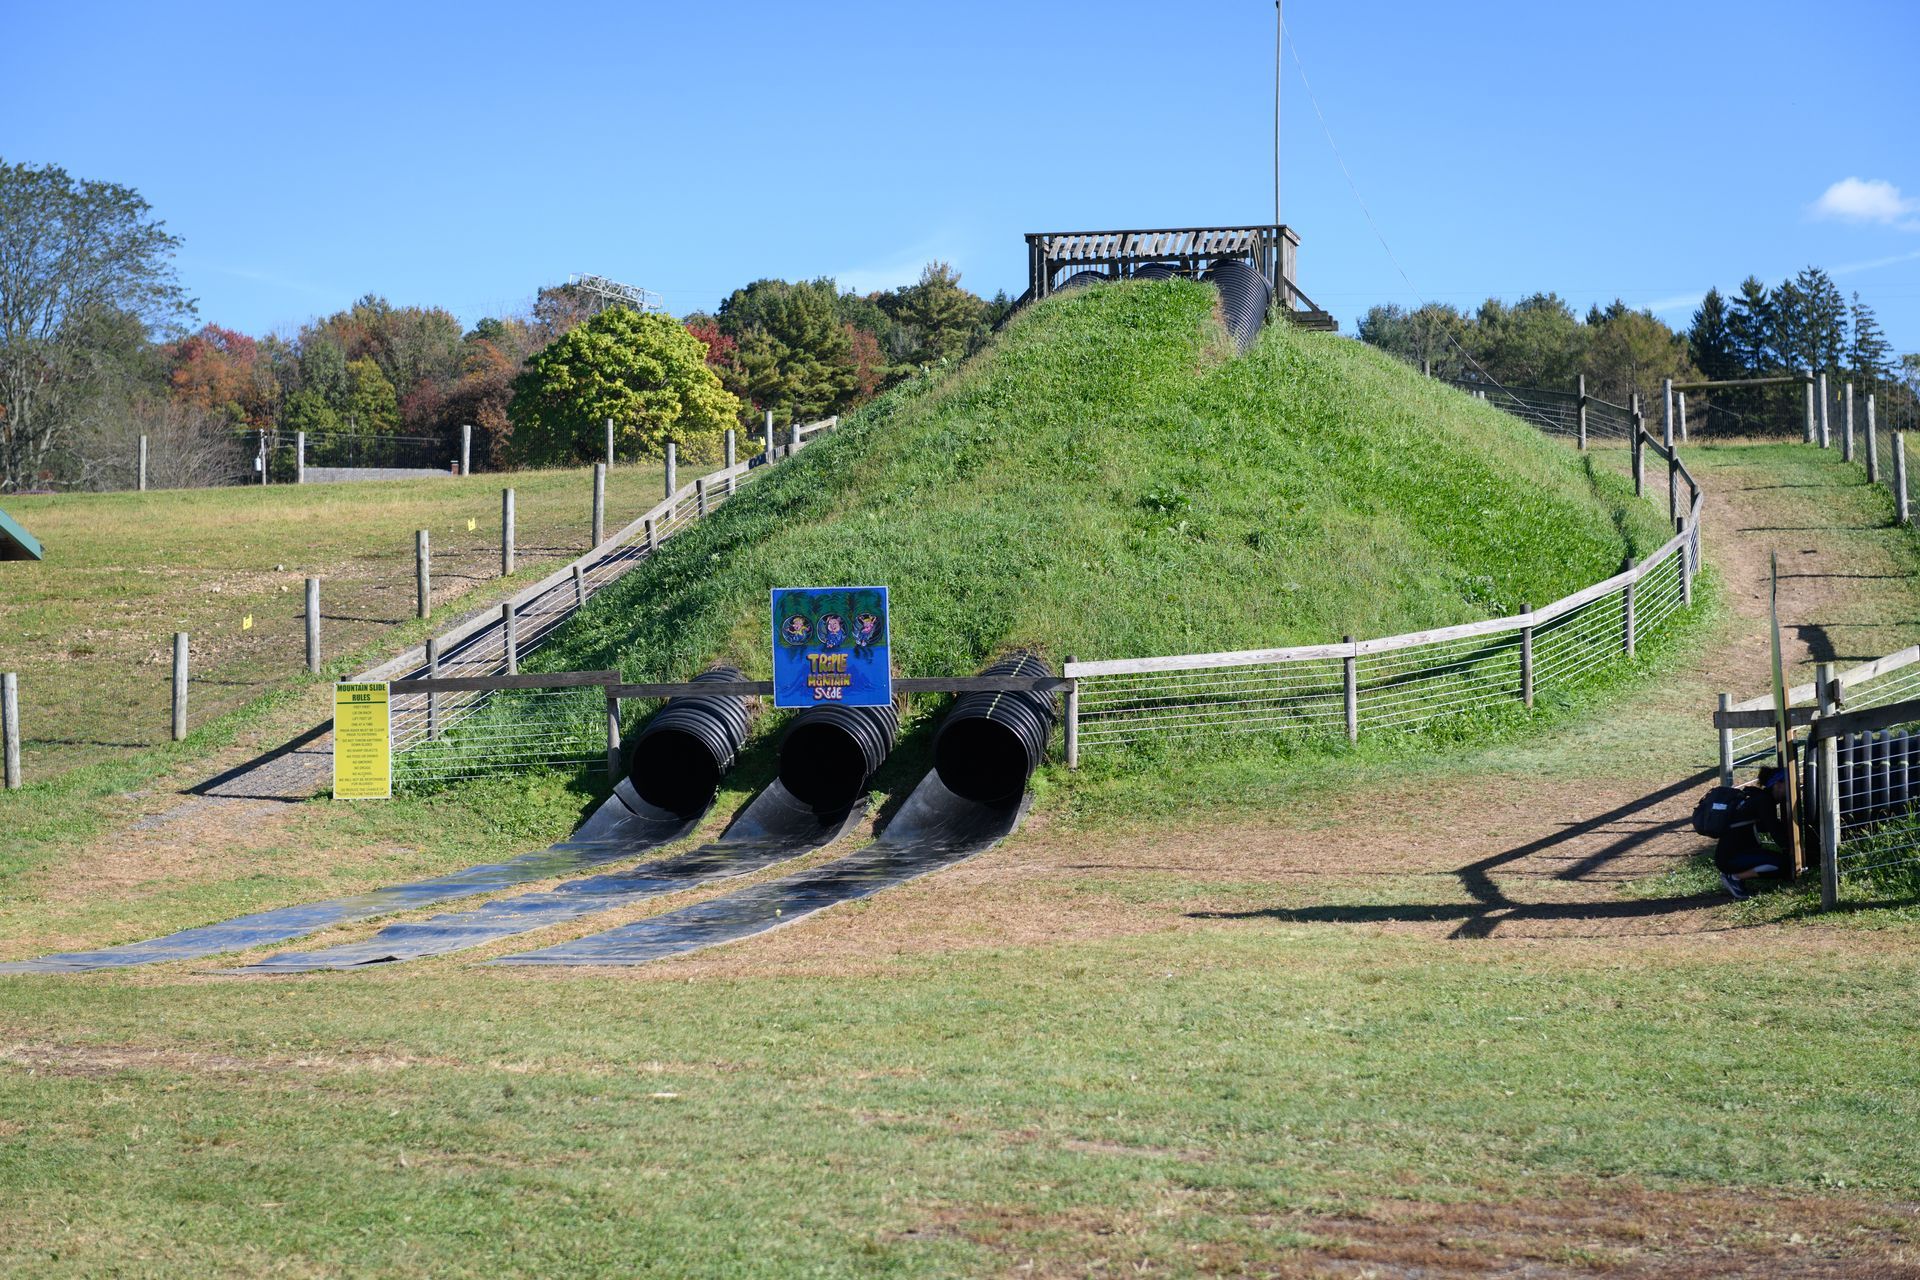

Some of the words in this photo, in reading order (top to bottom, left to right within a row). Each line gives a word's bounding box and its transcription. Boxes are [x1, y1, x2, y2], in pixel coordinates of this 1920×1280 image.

[336, 684, 369, 692] MOUNTAIN
[369, 683, 386, 691] SLIDE
[352, 693, 371, 701] RULES
